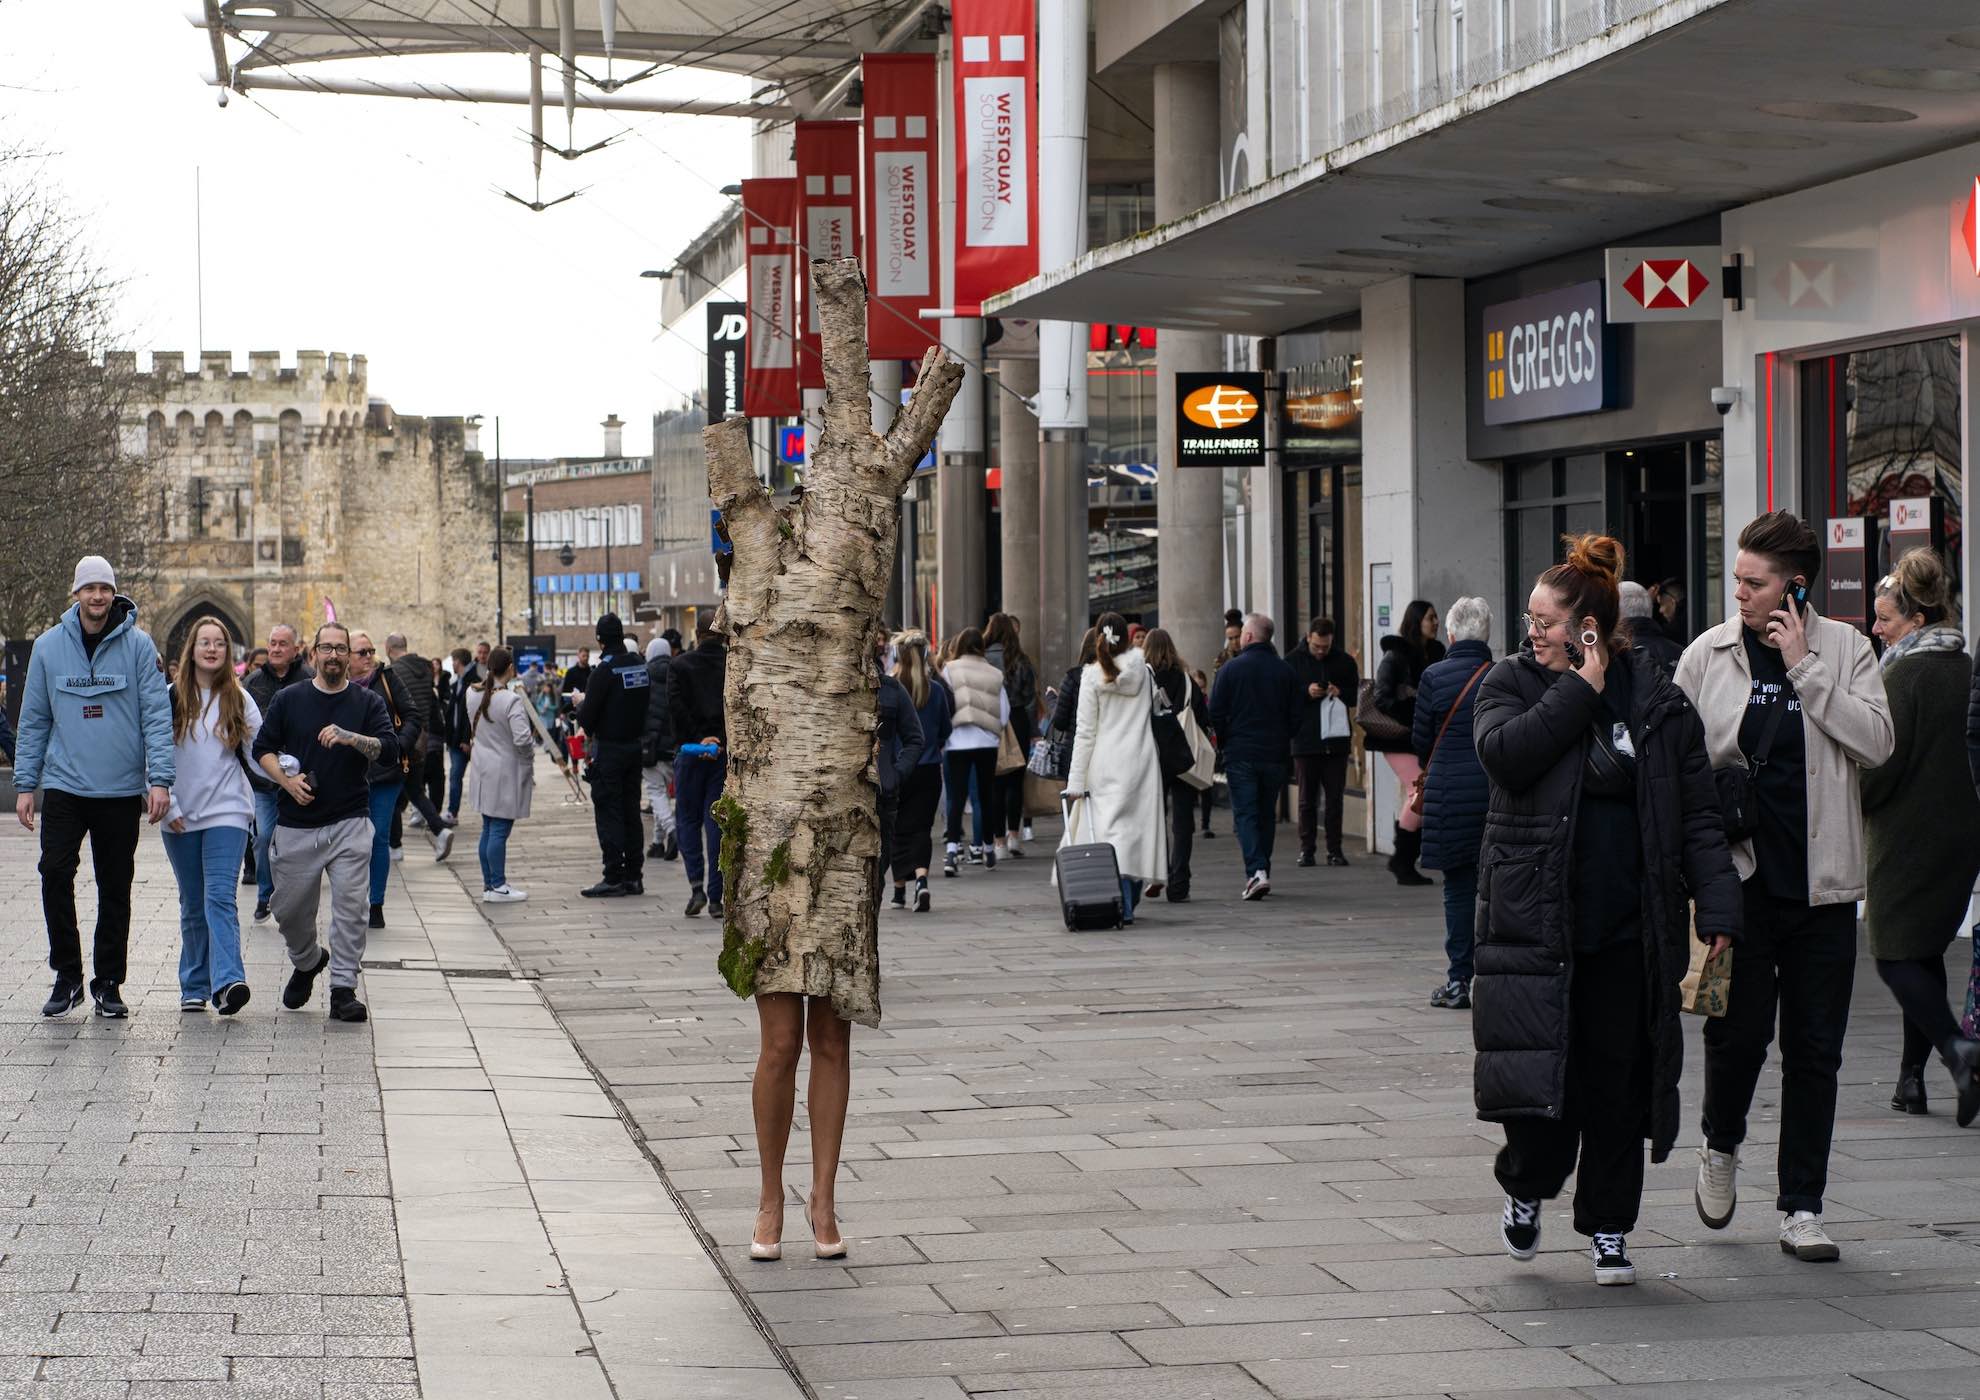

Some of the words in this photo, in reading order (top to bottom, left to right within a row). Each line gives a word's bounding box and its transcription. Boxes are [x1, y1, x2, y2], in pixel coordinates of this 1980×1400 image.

[980, 94, 995, 231] SOUTHAMPTON
[997, 92, 1011, 204] WESTQUAY
[831, 218, 841, 258] WEST
[888, 166, 901, 283] SOUTHAMPTON
[902, 165, 916, 261] WESTQUAY
[713, 314, 748, 341] JD
[771, 265, 782, 340] WESTQUAY
[1509, 307, 1596, 395] GREGGS
[1182, 438, 1259, 449] TRAILFINDERS
[1787, 700, 1801, 711] UC
